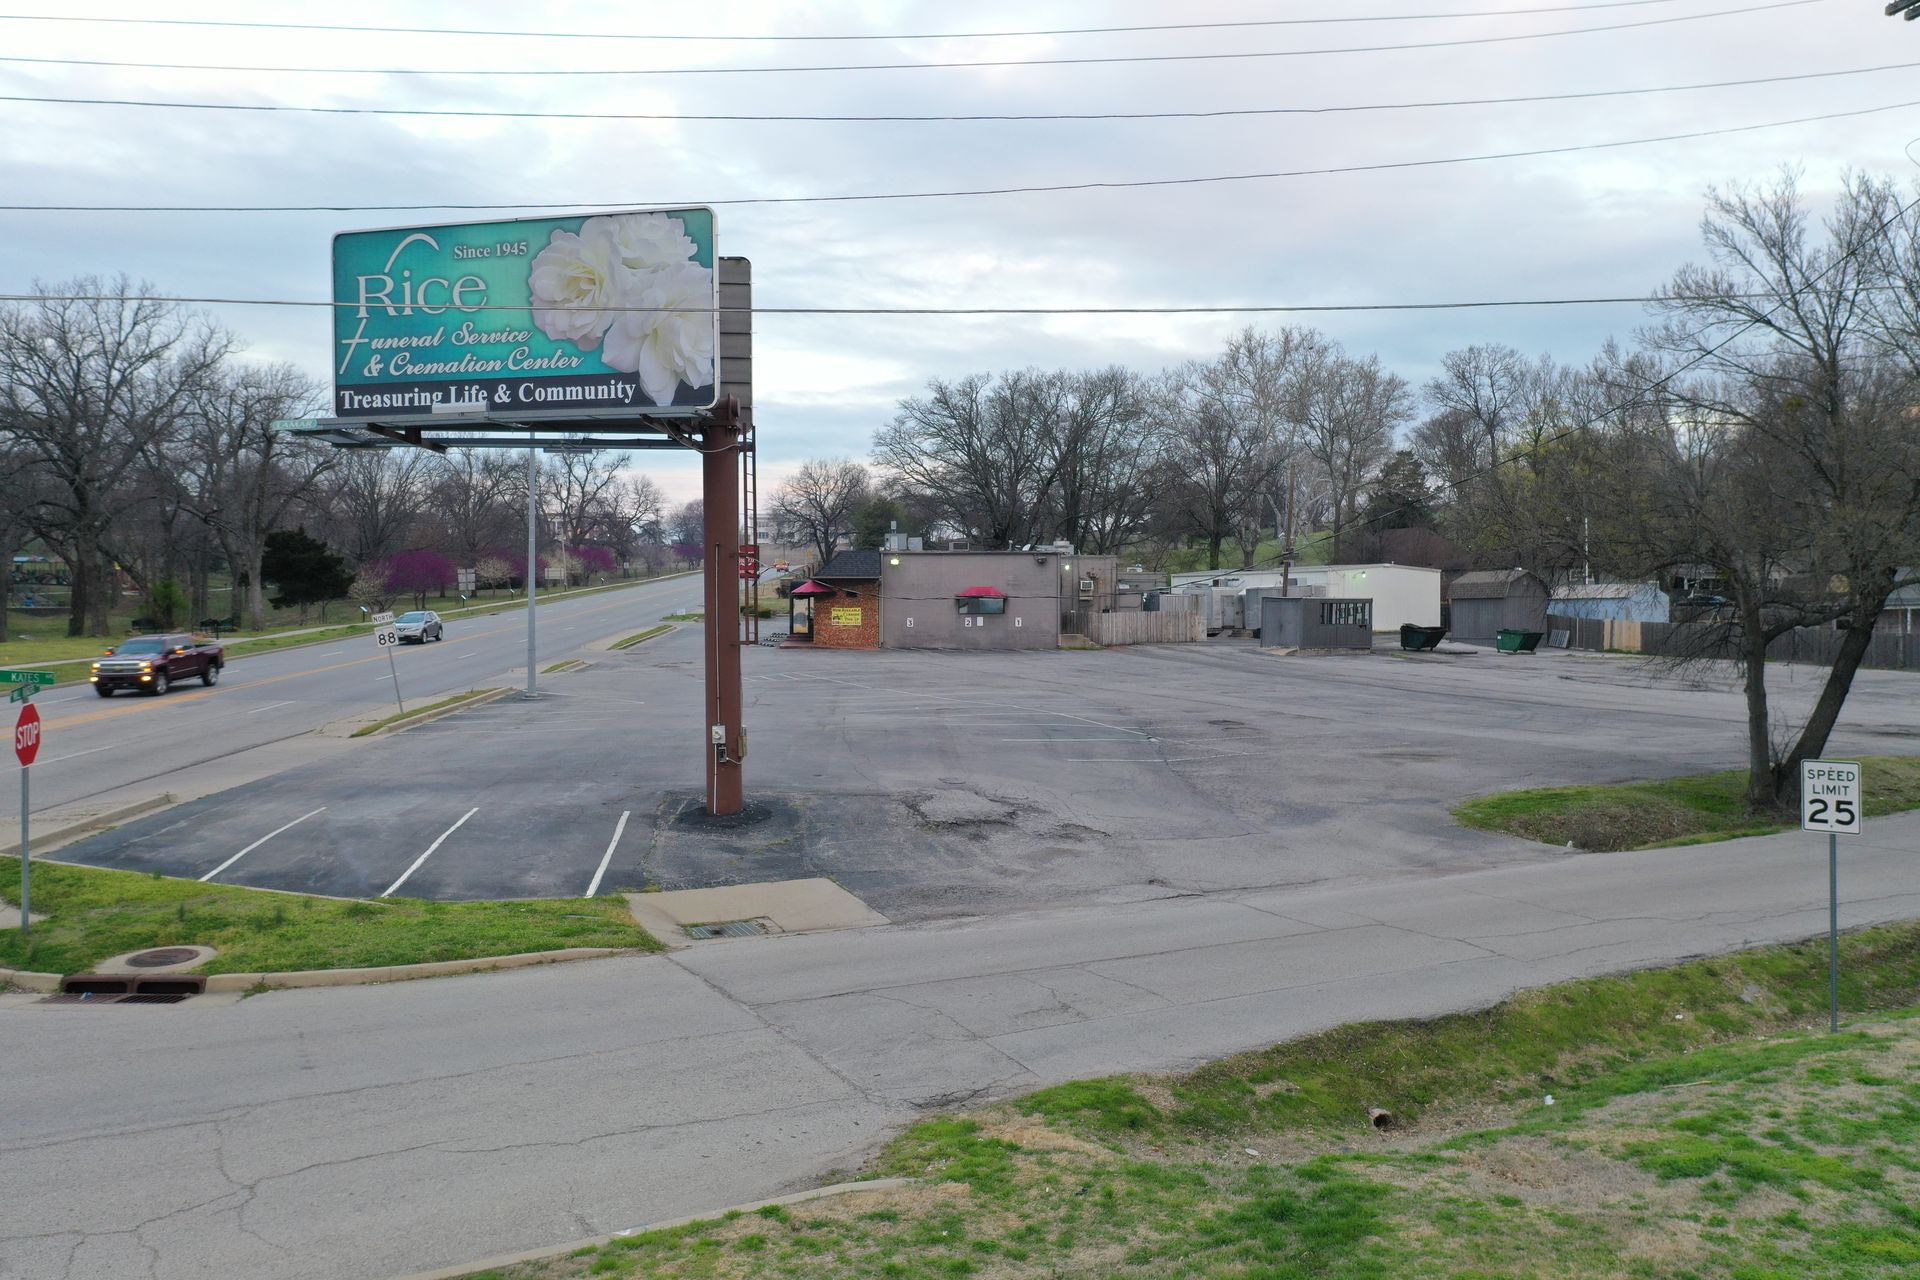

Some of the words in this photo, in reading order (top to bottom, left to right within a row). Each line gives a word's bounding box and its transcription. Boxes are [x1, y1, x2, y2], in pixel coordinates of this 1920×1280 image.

[454, 245, 491, 259] Since
[495, 242, 527, 257] 1945
[356, 270, 488, 318] Rice
[451, 321, 534, 346] Service
[363, 354, 384, 377] &
[389, 352, 508, 376] Cremation
[508, 346, 584, 370] Center
[340, 387, 443, 409] Treasuring
[449, 384, 488, 404] Life
[494, 384, 511, 402] &
[518, 379, 636, 403] Community
[373, 614, 393, 623] NORTH
[378, 632, 396, 645] 88
[11, 672, 40, 682] KATES
[16, 721, 38, 749] STOP
[1807, 769, 1855, 782] SPEED
[1812, 784, 1850, 796] LIMIT
[1808, 798, 1856, 826] 25
